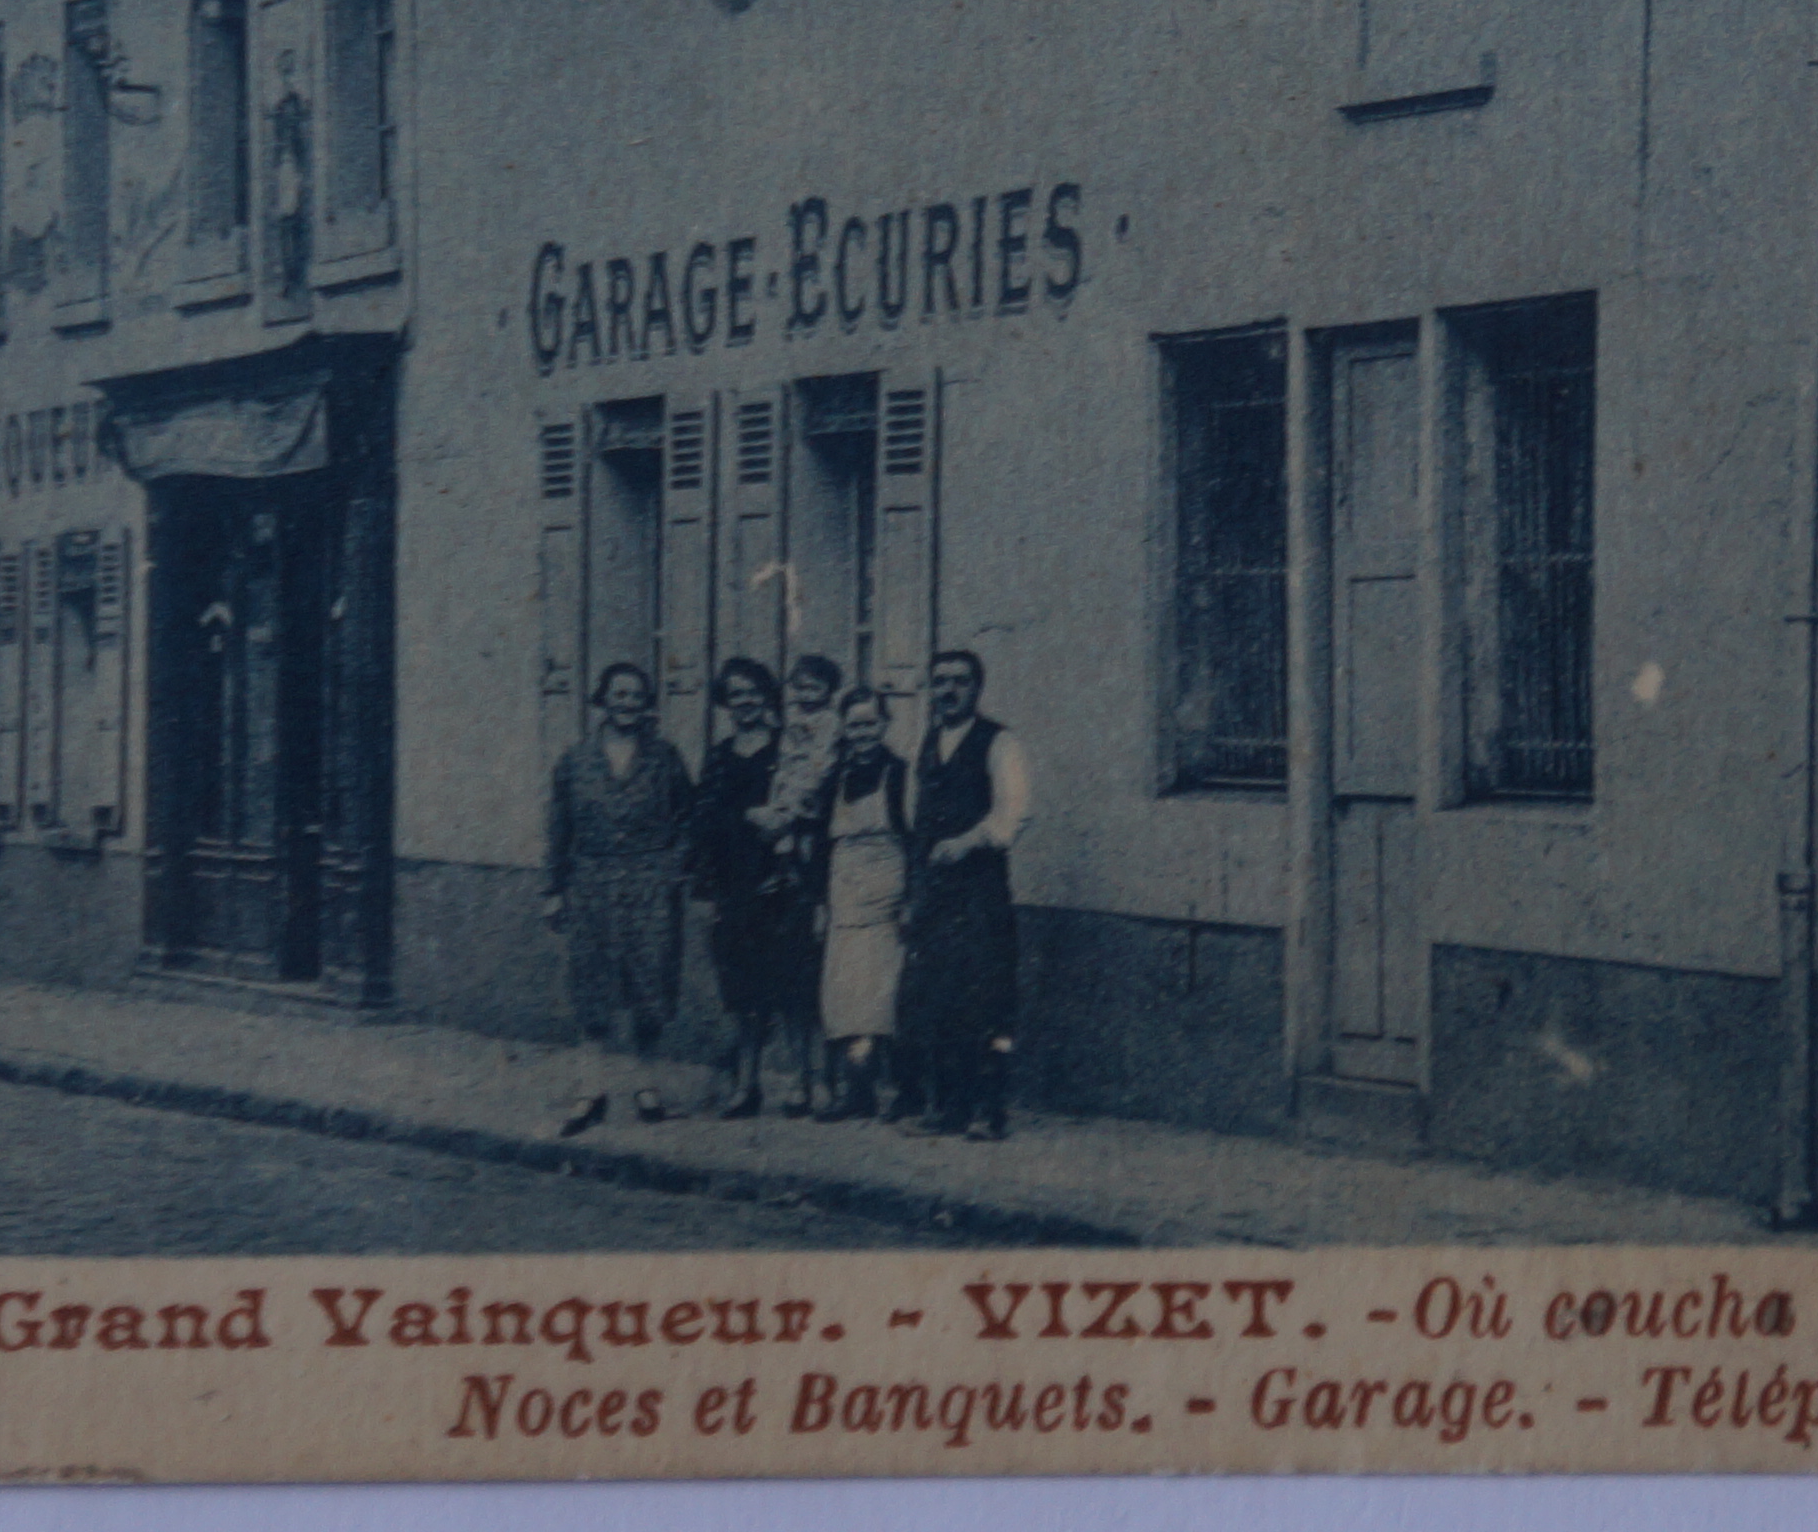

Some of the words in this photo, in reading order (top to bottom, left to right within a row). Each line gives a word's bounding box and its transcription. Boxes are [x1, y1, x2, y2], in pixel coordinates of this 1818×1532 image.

[528, 236, 758, 374] GARAGE
[310, 1285, 847, 1362] Vainqueur.
[961, 1281, 1329, 1341] VIZET.
[1543, 1272, 1797, 1342] coucha
[445, 1375, 665, 1441] Noces
[692, 1377, 758, 1436] et
[789, 1371, 1155, 1449] Banquets.
[1249, 1368, 1536, 1444] Garage.
